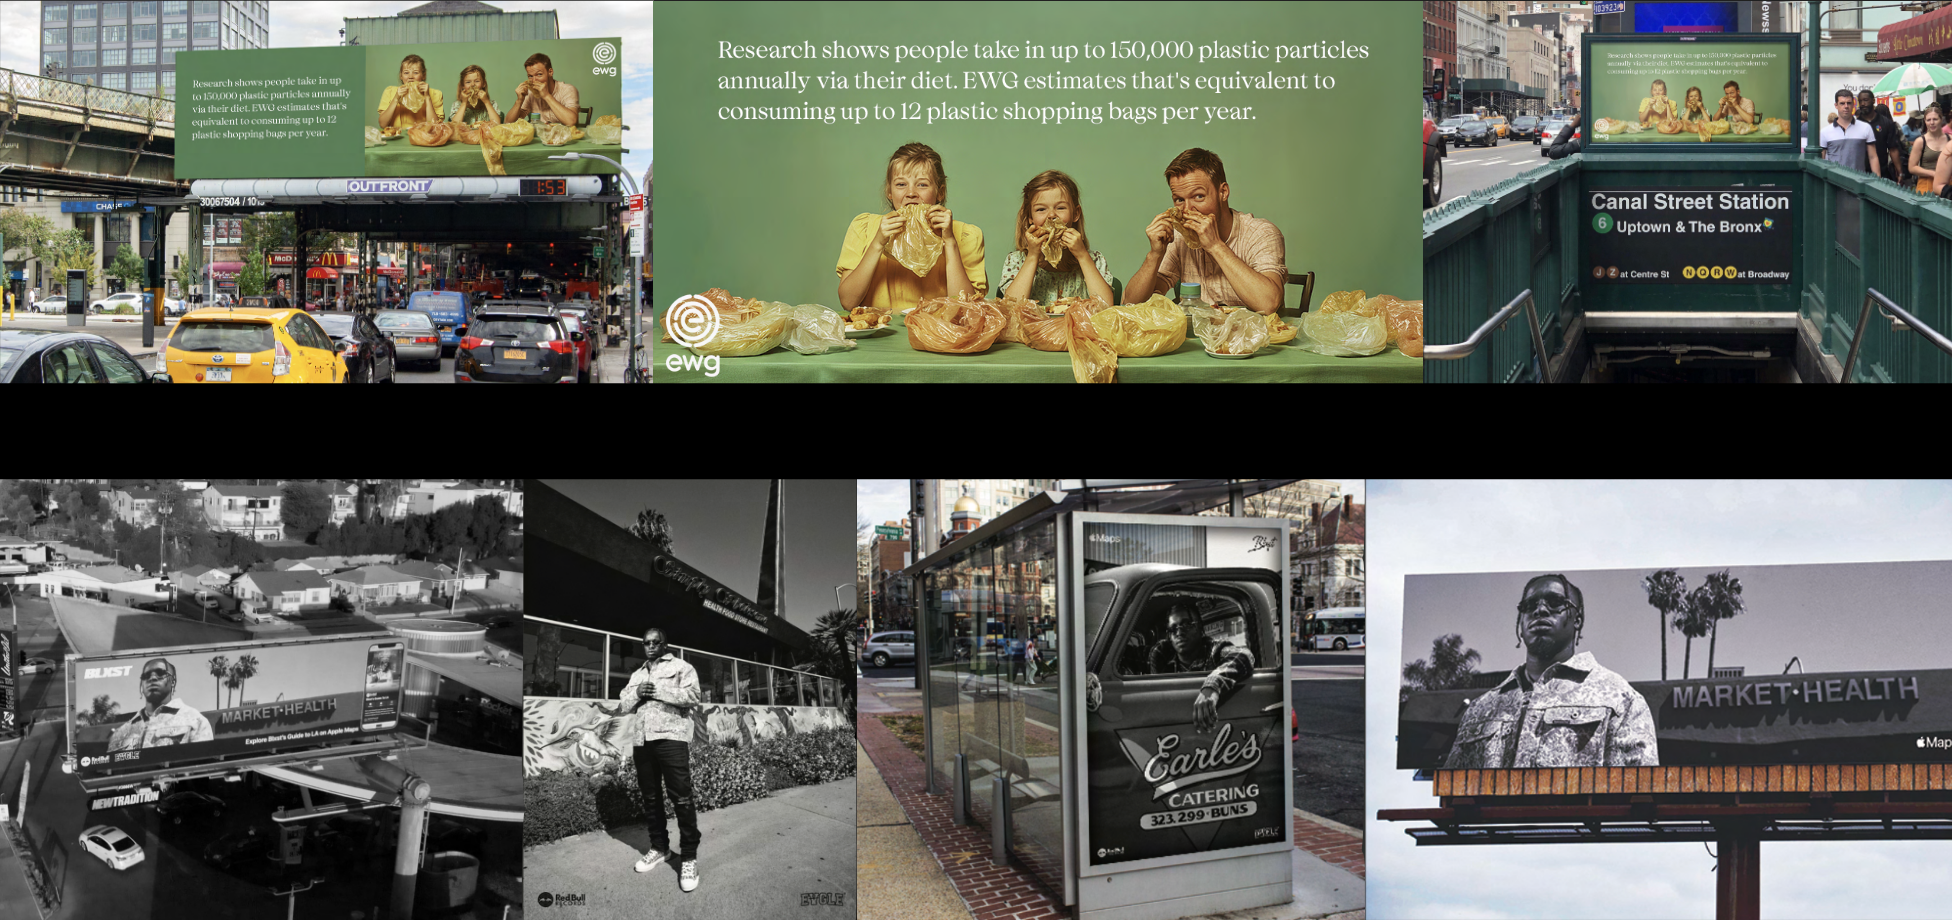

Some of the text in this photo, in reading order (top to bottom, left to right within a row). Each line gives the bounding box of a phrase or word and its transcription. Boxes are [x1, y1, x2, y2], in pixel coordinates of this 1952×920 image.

[718, 40, 1369, 62] Research shows people take in up to 150,000 plastic particles
[592, 67, 616, 76] ewg
[193, 76, 342, 88] Research shows people take in up
[718, 71, 1335, 94] annually via their diet. EWG estimates that's equivalent to
[203, 92, 238, 101] 150,000
[239, 90, 268, 102] plastic
[270, 90, 310, 100] particles
[311, 88, 350, 99] annually
[192, 102, 347, 114] via their diet. EWG estimates that's
[718, 102, 1256, 124] consuming up to 12 plastic shopping bags per year.
[192, 115, 337, 127] equivalent to consuming up to 12
[192, 129, 328, 141] plastic shopping bags per year.
[349, 180, 429, 193] OUTFRONT
[538, 180, 565, 195] 1:53
[200, 197, 240, 206] 30067504
[1592, 193, 1789, 210] Canal Street Station
[1598, 217, 1762, 235] 6 Uptown & The Bronx
[1748, 271, 1789, 280] Broadway
[666, 354, 720, 377] ewg
[1096, 534, 1121, 543] Maps
[703, 600, 768, 634] HEALTH FOOD STORE RESTAURANT
[84, 665, 133, 679] BLXST
[245, 737, 267, 745] Explore
[1144, 723, 1261, 782] Earle's
[1169, 784, 1259, 807] CATERING
